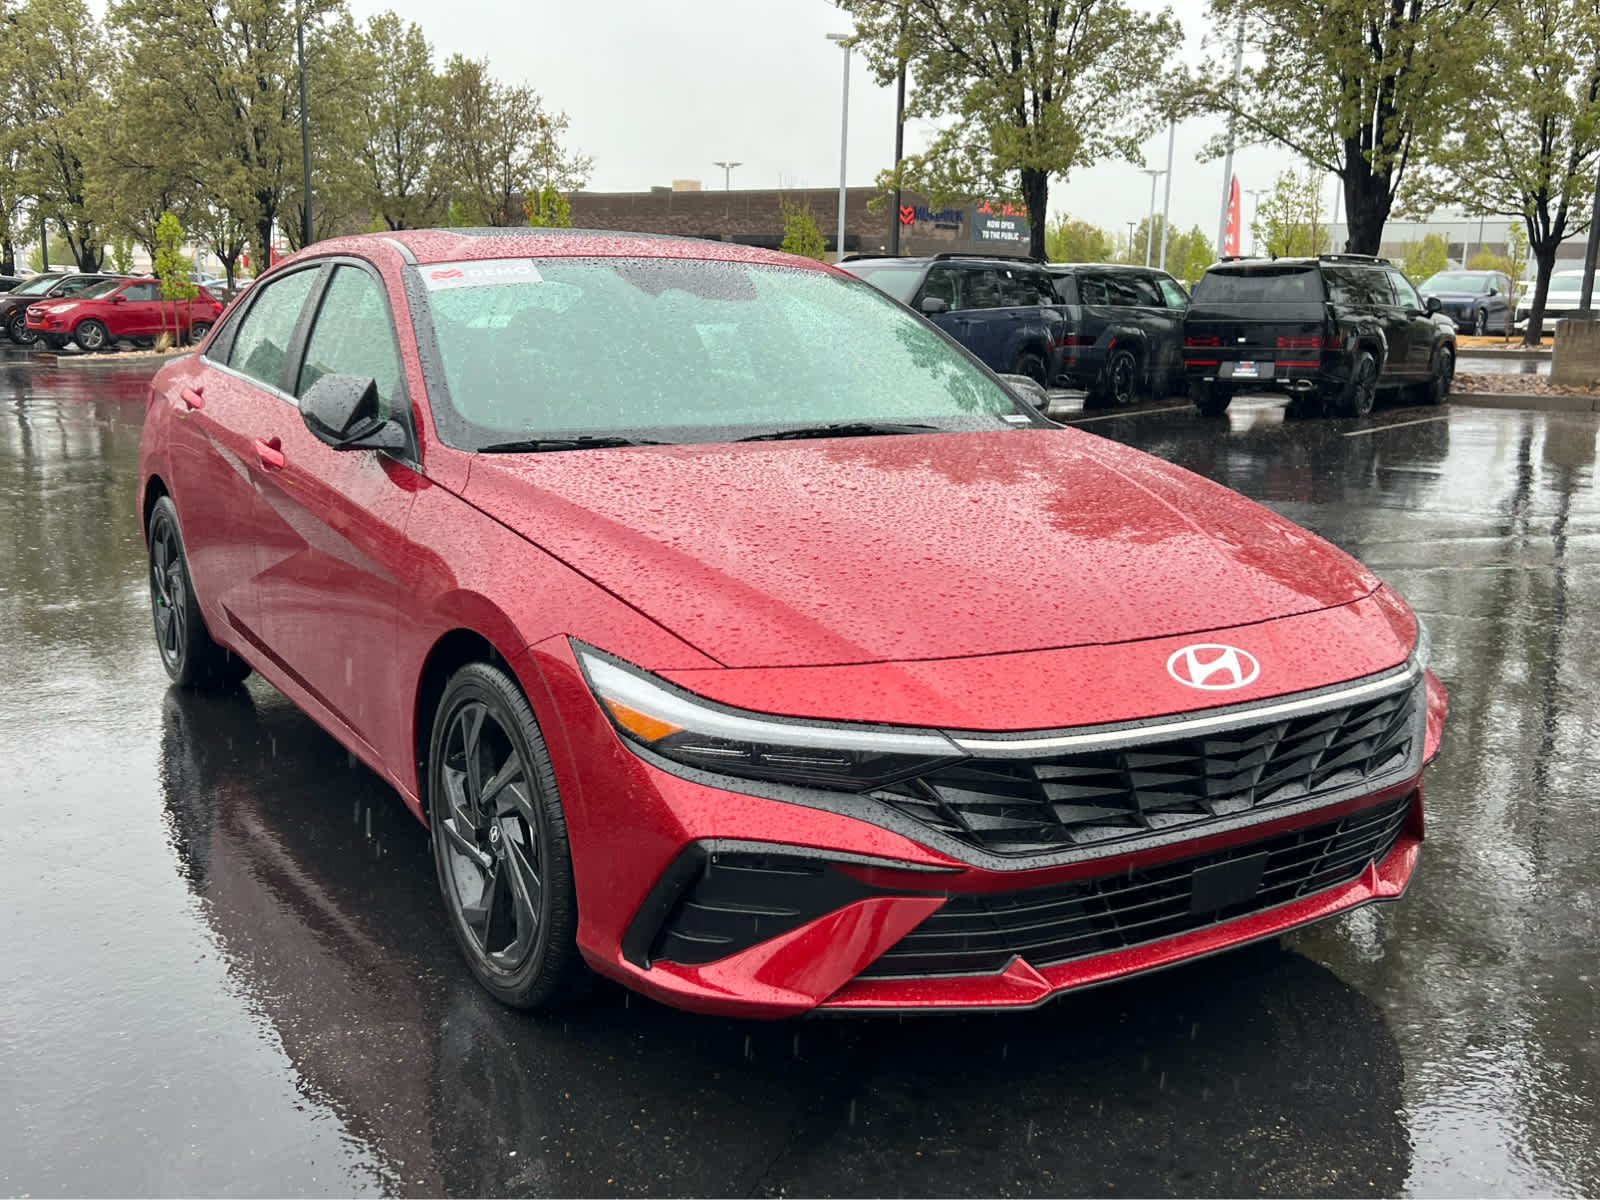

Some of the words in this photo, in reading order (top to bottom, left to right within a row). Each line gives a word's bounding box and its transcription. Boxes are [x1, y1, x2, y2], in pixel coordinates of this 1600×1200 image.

[986, 220, 1000, 229] NOW
[1001, 221, 1015, 230] OPEN
[982, 230, 990, 239] TO
[990, 231, 1001, 240] THE
[1001, 232, 1020, 241] PUBLIC
